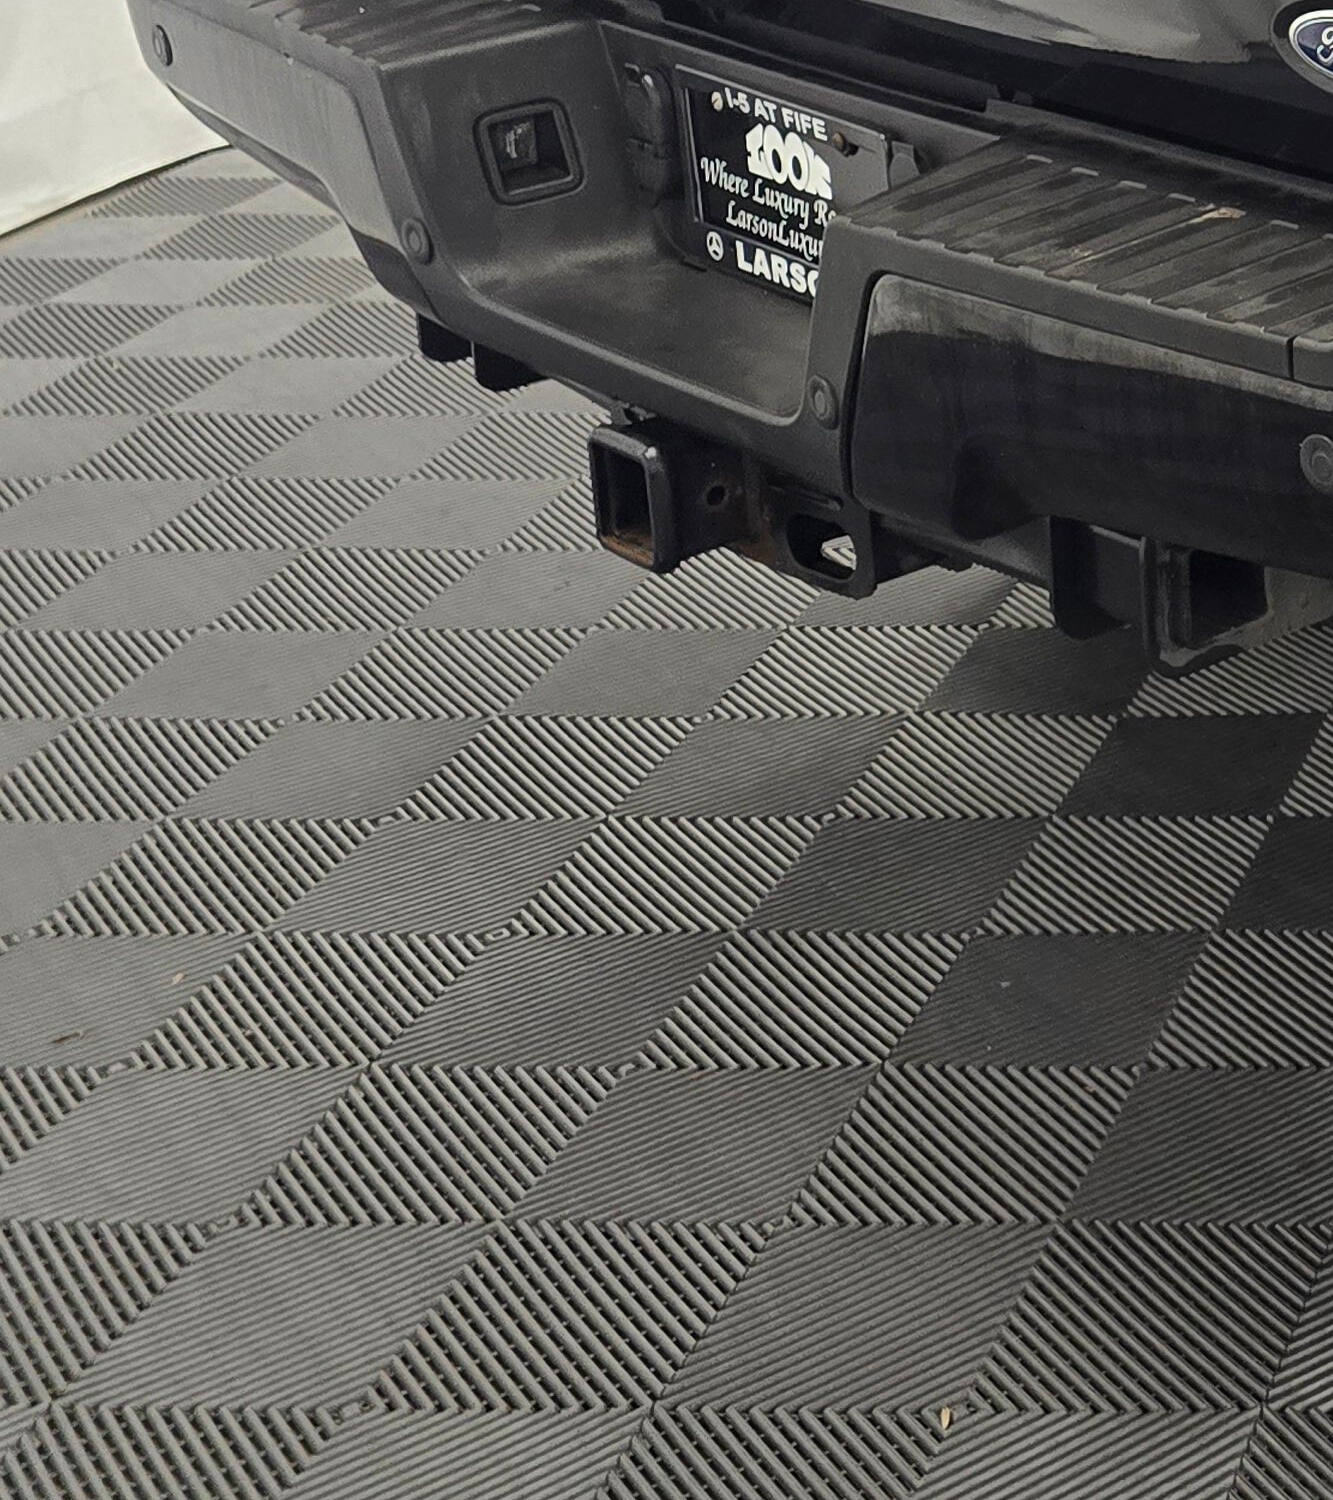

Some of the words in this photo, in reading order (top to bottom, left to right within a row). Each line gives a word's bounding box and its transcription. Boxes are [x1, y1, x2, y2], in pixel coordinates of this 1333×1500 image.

[754, 97, 777, 123] AT
[781, 106, 828, 141] FIFE
[700, 156, 749, 198] Where
[752, 178, 810, 229] Luxury
